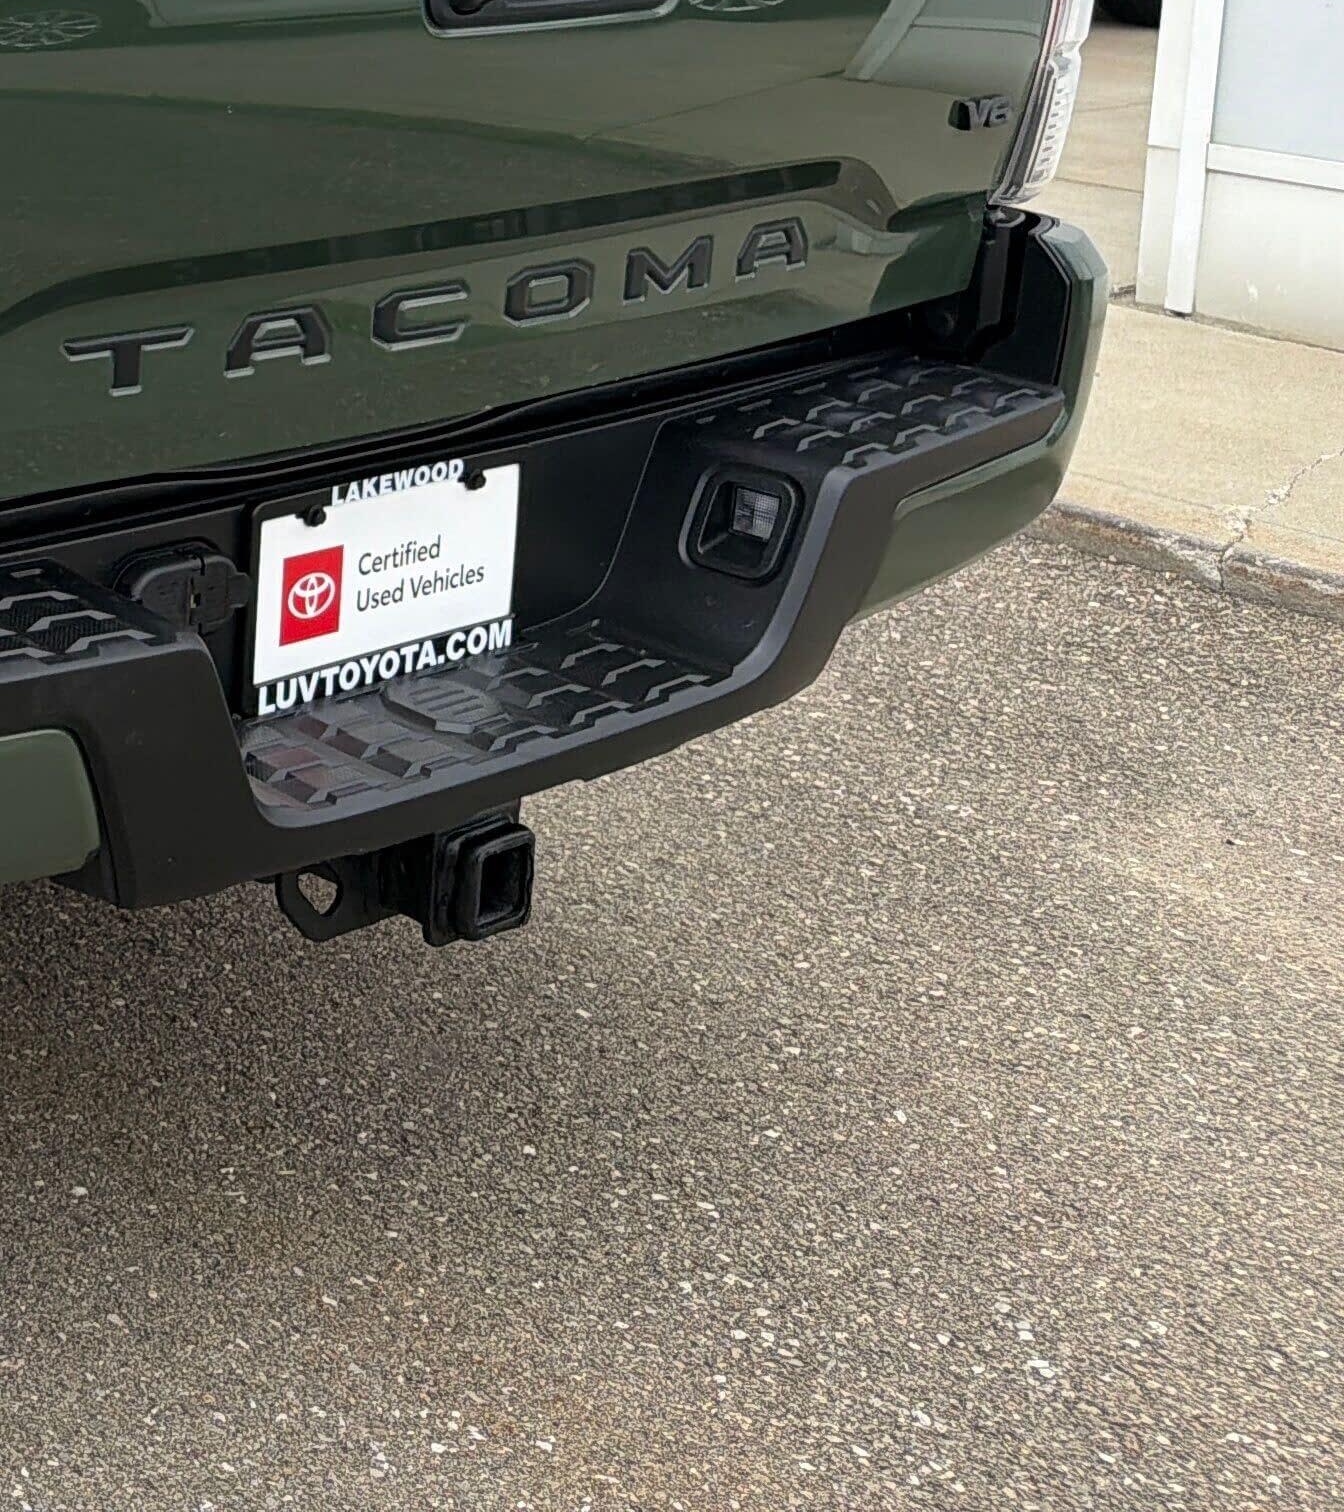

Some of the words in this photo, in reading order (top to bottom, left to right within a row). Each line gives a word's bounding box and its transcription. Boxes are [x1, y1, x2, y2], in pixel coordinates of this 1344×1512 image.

[62, 215, 810, 398] TACOMA
[331, 458, 464, 507] LAKEWOOD
[358, 534, 442, 576] Certified
[356, 577, 405, 612] Used
[410, 563, 486, 600] Vehicles
[257, 619, 513, 717] LUVTOYOTA.COM
